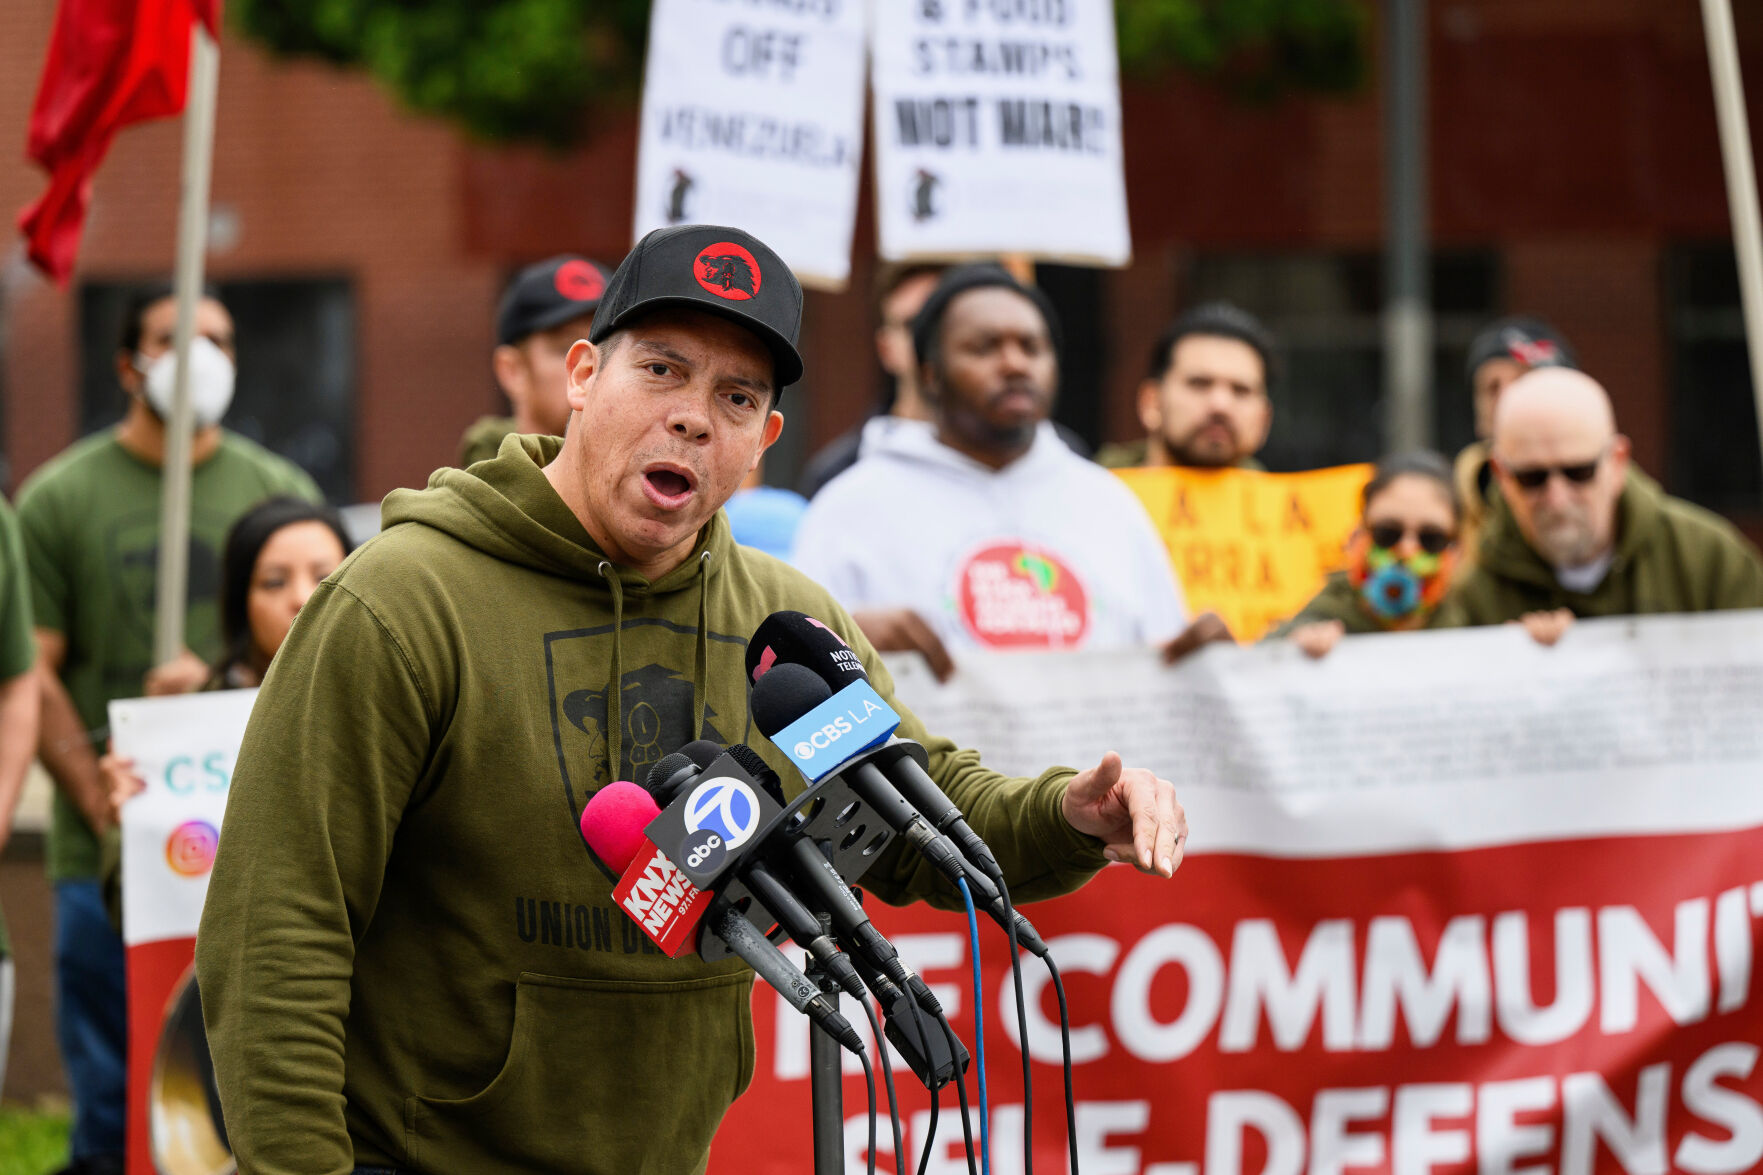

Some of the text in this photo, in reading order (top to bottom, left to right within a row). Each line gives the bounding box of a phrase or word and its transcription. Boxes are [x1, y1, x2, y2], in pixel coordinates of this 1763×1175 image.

[722, 25, 803, 80] OFF
[913, 38, 1080, 82] STAMPS
[894, 97, 978, 147] NOT
[810, 699, 882, 749] CBS LA
[687, 834, 721, 868] abc
[622, 848, 677, 922] KNX
[642, 868, 692, 937] NEWS
[678, 896, 693, 916] 97.1
[515, 897, 613, 953] UNION
[756, 933, 966, 1081] HE
